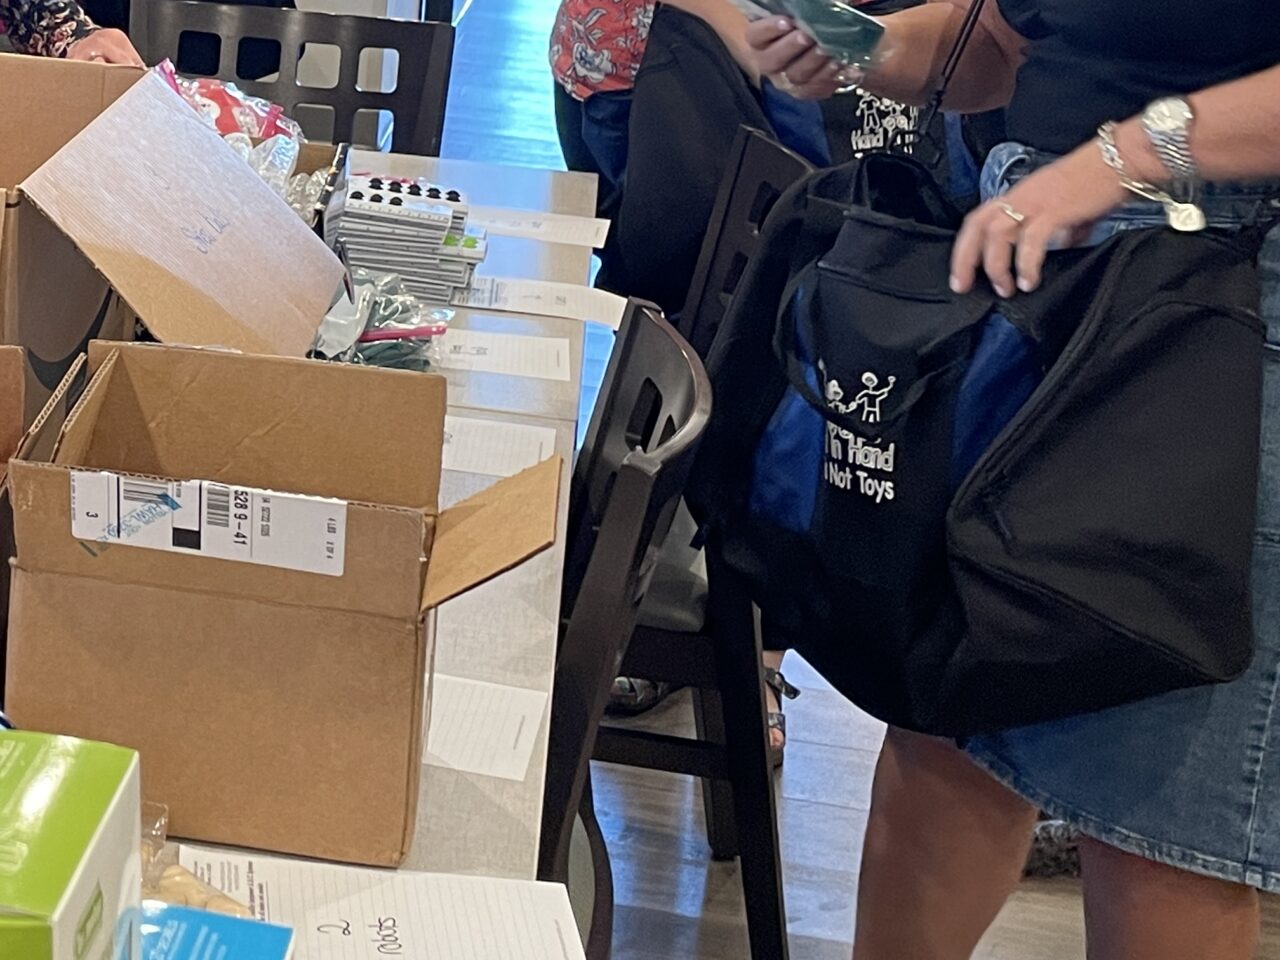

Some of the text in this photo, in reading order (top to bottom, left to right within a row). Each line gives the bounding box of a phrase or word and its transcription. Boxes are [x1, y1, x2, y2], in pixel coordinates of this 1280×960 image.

[848, 437, 895, 472] Hand
[829, 462, 895, 504] Not Toys
[233, 489, 249, 545] 528 9-41
[317, 918, 351, 936] 2
[367, 917, 403, 955] robots
